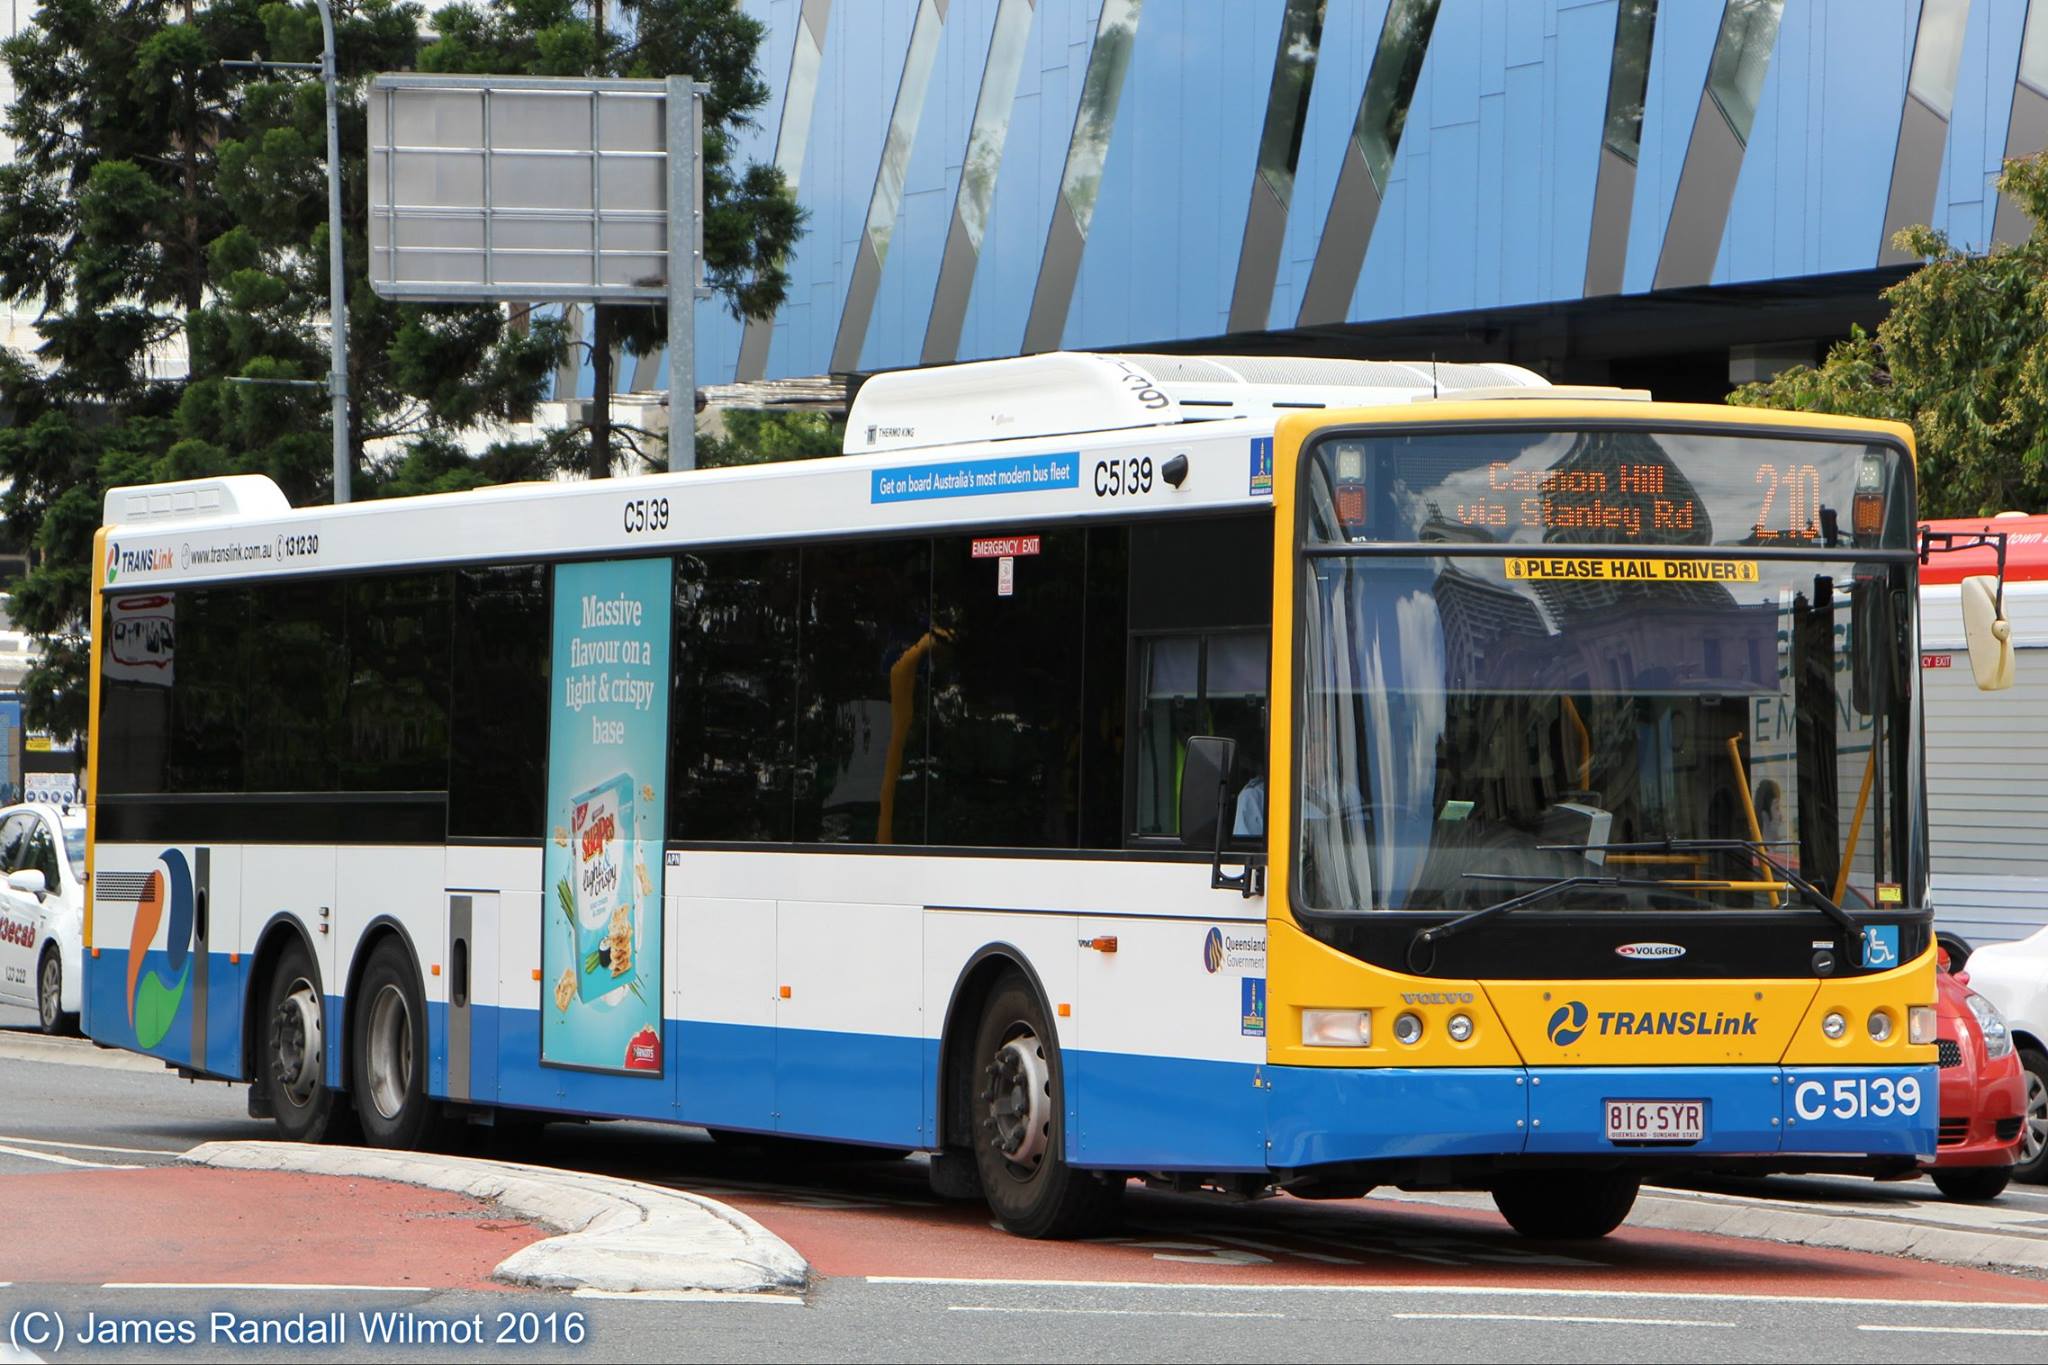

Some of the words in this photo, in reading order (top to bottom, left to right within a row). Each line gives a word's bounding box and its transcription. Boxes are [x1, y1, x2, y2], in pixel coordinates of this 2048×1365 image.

[879, 428, 901, 438] THERMO
[902, 427, 915, 437] KING
[880, 477, 894, 495] Get
[896, 481, 907, 493] on
[908, 473, 932, 492] board
[933, 469, 974, 490] Australia's
[976, 472, 997, 487] most
[998, 468, 1031, 484] modern
[1033, 465, 1048, 481] bus
[1050, 462, 1070, 480] fleet
[1094, 456, 1152, 497] C5139
[1489, 462, 1606, 492] Cannon
[1621, 464, 1664, 493] Hill
[1754, 464, 1820, 539] 210
[624, 497, 669, 533] C5139
[1457, 497, 1507, 525] via
[1521, 497, 1640, 536] Stanley
[1654, 499, 1693, 529] Rd
[191, 541, 272, 565] www.translink.com.au
[972, 540, 1019, 555] EMERGENCY
[1023, 538, 1040, 553] EXIT
[122, 547, 173, 573] TRANSLink
[1527, 560, 1604, 577] PLEASE
[1611, 561, 1657, 578] HAIL
[1663, 562, 1736, 580] DRIVER
[582, 592, 642, 629] Massive
[571, 638, 620, 668] flavour
[622, 640, 640, 665] on
[642, 642, 651, 666] a
[1935, 655, 1950, 667] EXIT
[566, 674, 596, 712] light
[598, 673, 609, 703] &
[612, 673, 654, 710] crispy
[592, 716, 625, 744] base
[1225, 936, 1266, 952] Queensland
[1636, 946, 1681, 955] VOLGREN
[1226, 953, 1265, 969] Government
[1400, 992, 1473, 1004] VOLVO
[1597, 1011, 1760, 1036] TRANSLink
